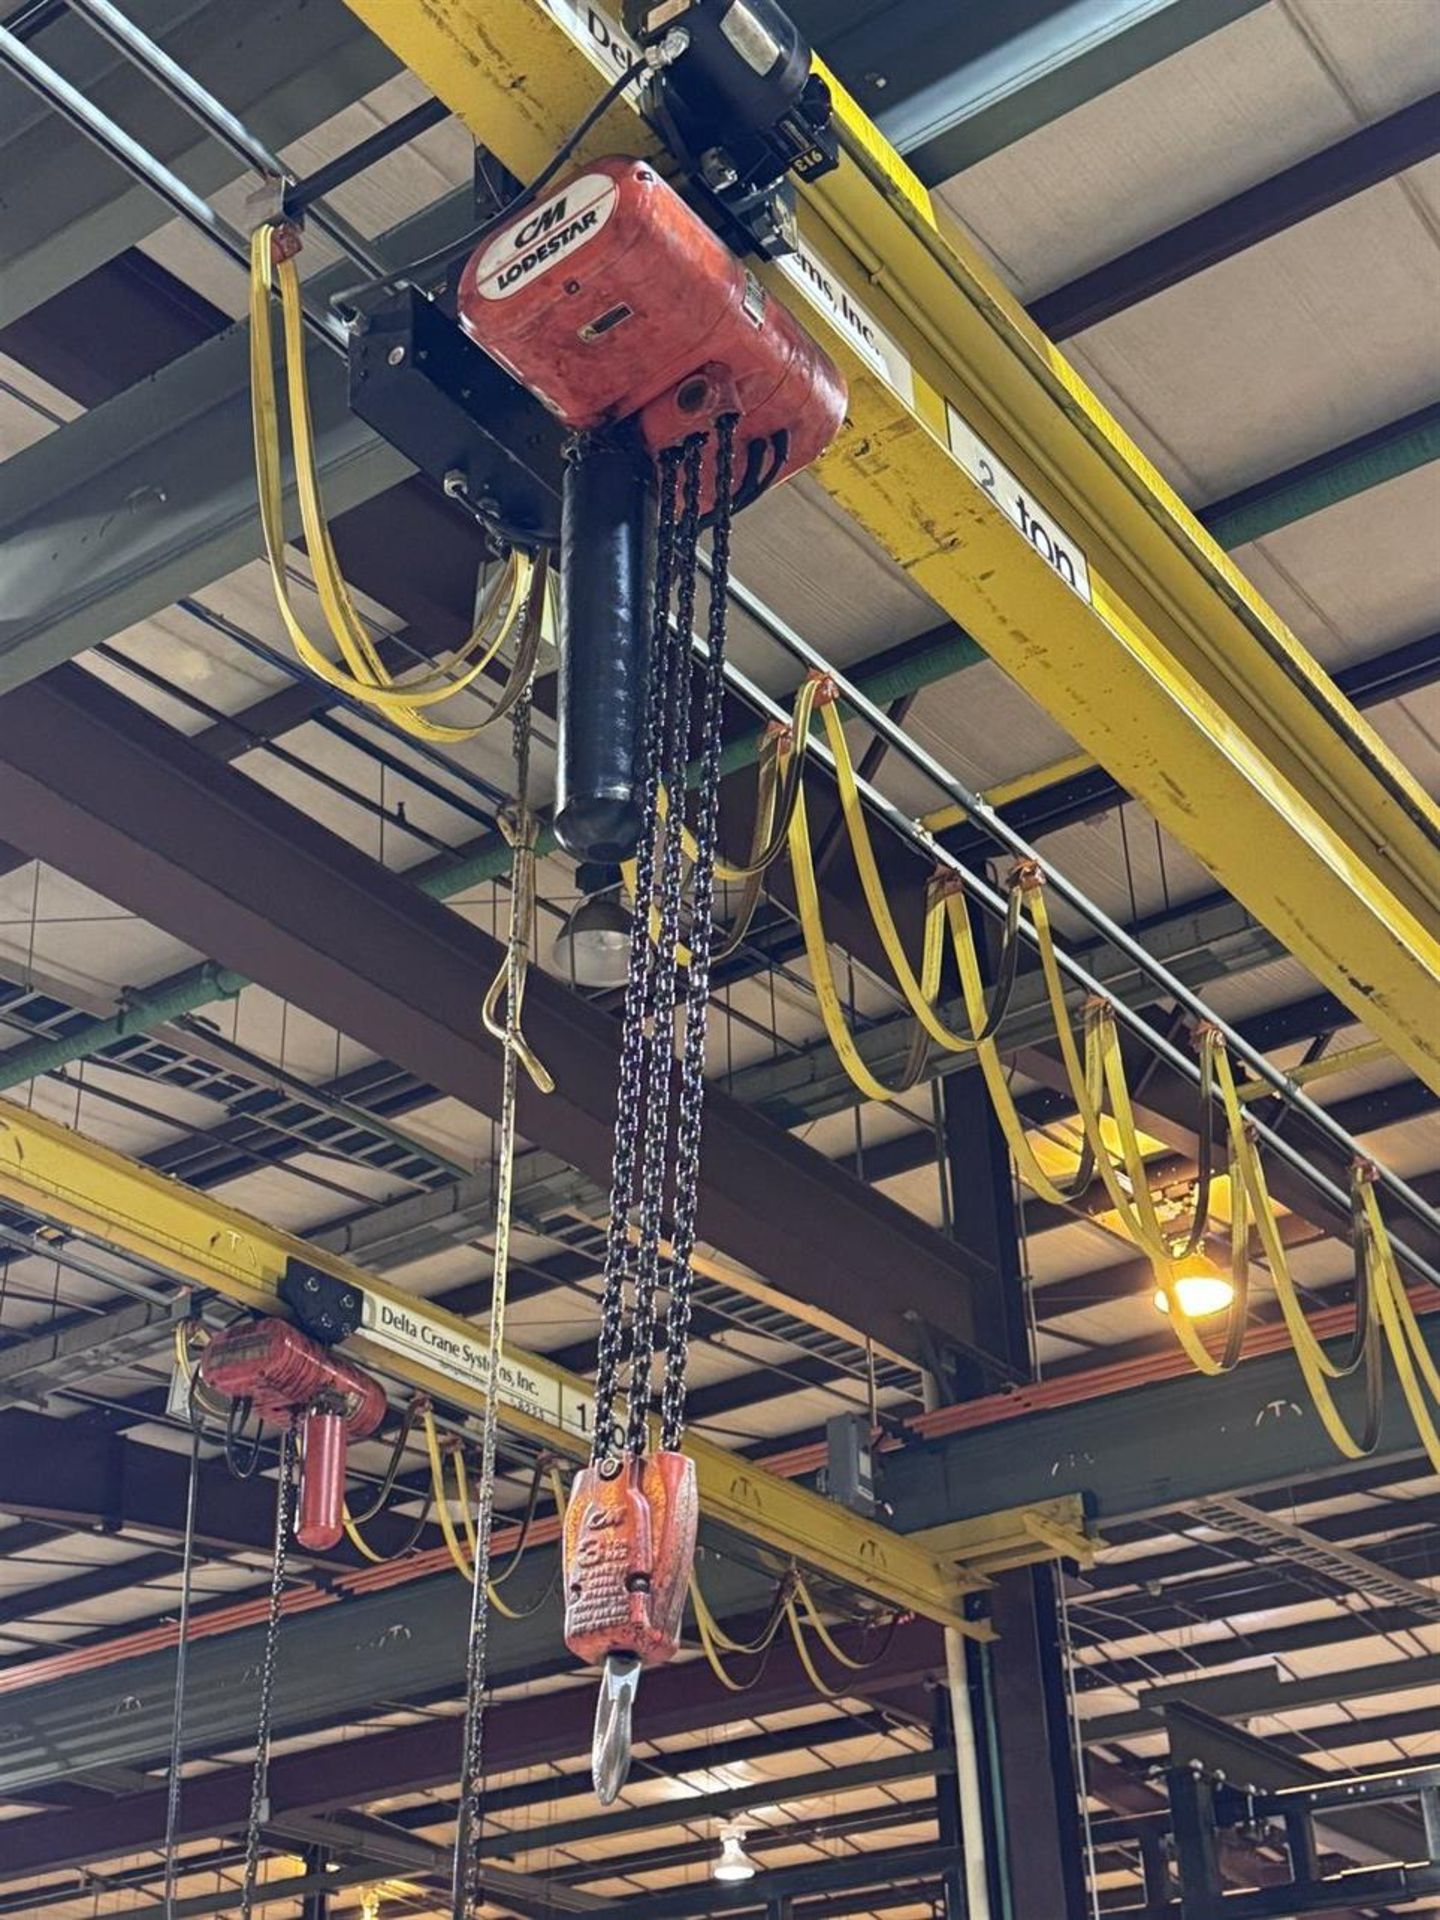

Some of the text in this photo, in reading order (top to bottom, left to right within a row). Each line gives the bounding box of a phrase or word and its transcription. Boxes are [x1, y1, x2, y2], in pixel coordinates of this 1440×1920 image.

[588, 7, 633, 70] Del
[497, 210, 598, 291] LODESTAR
[514, 197, 567, 249] CM
[842, 294, 880, 356] Inc.
[979, 459, 1076, 588] 2 ton
[381, 1306, 417, 1338] Delta
[421, 1325, 460, 1358] Crane
[517, 1371, 539, 1397] Inc.
